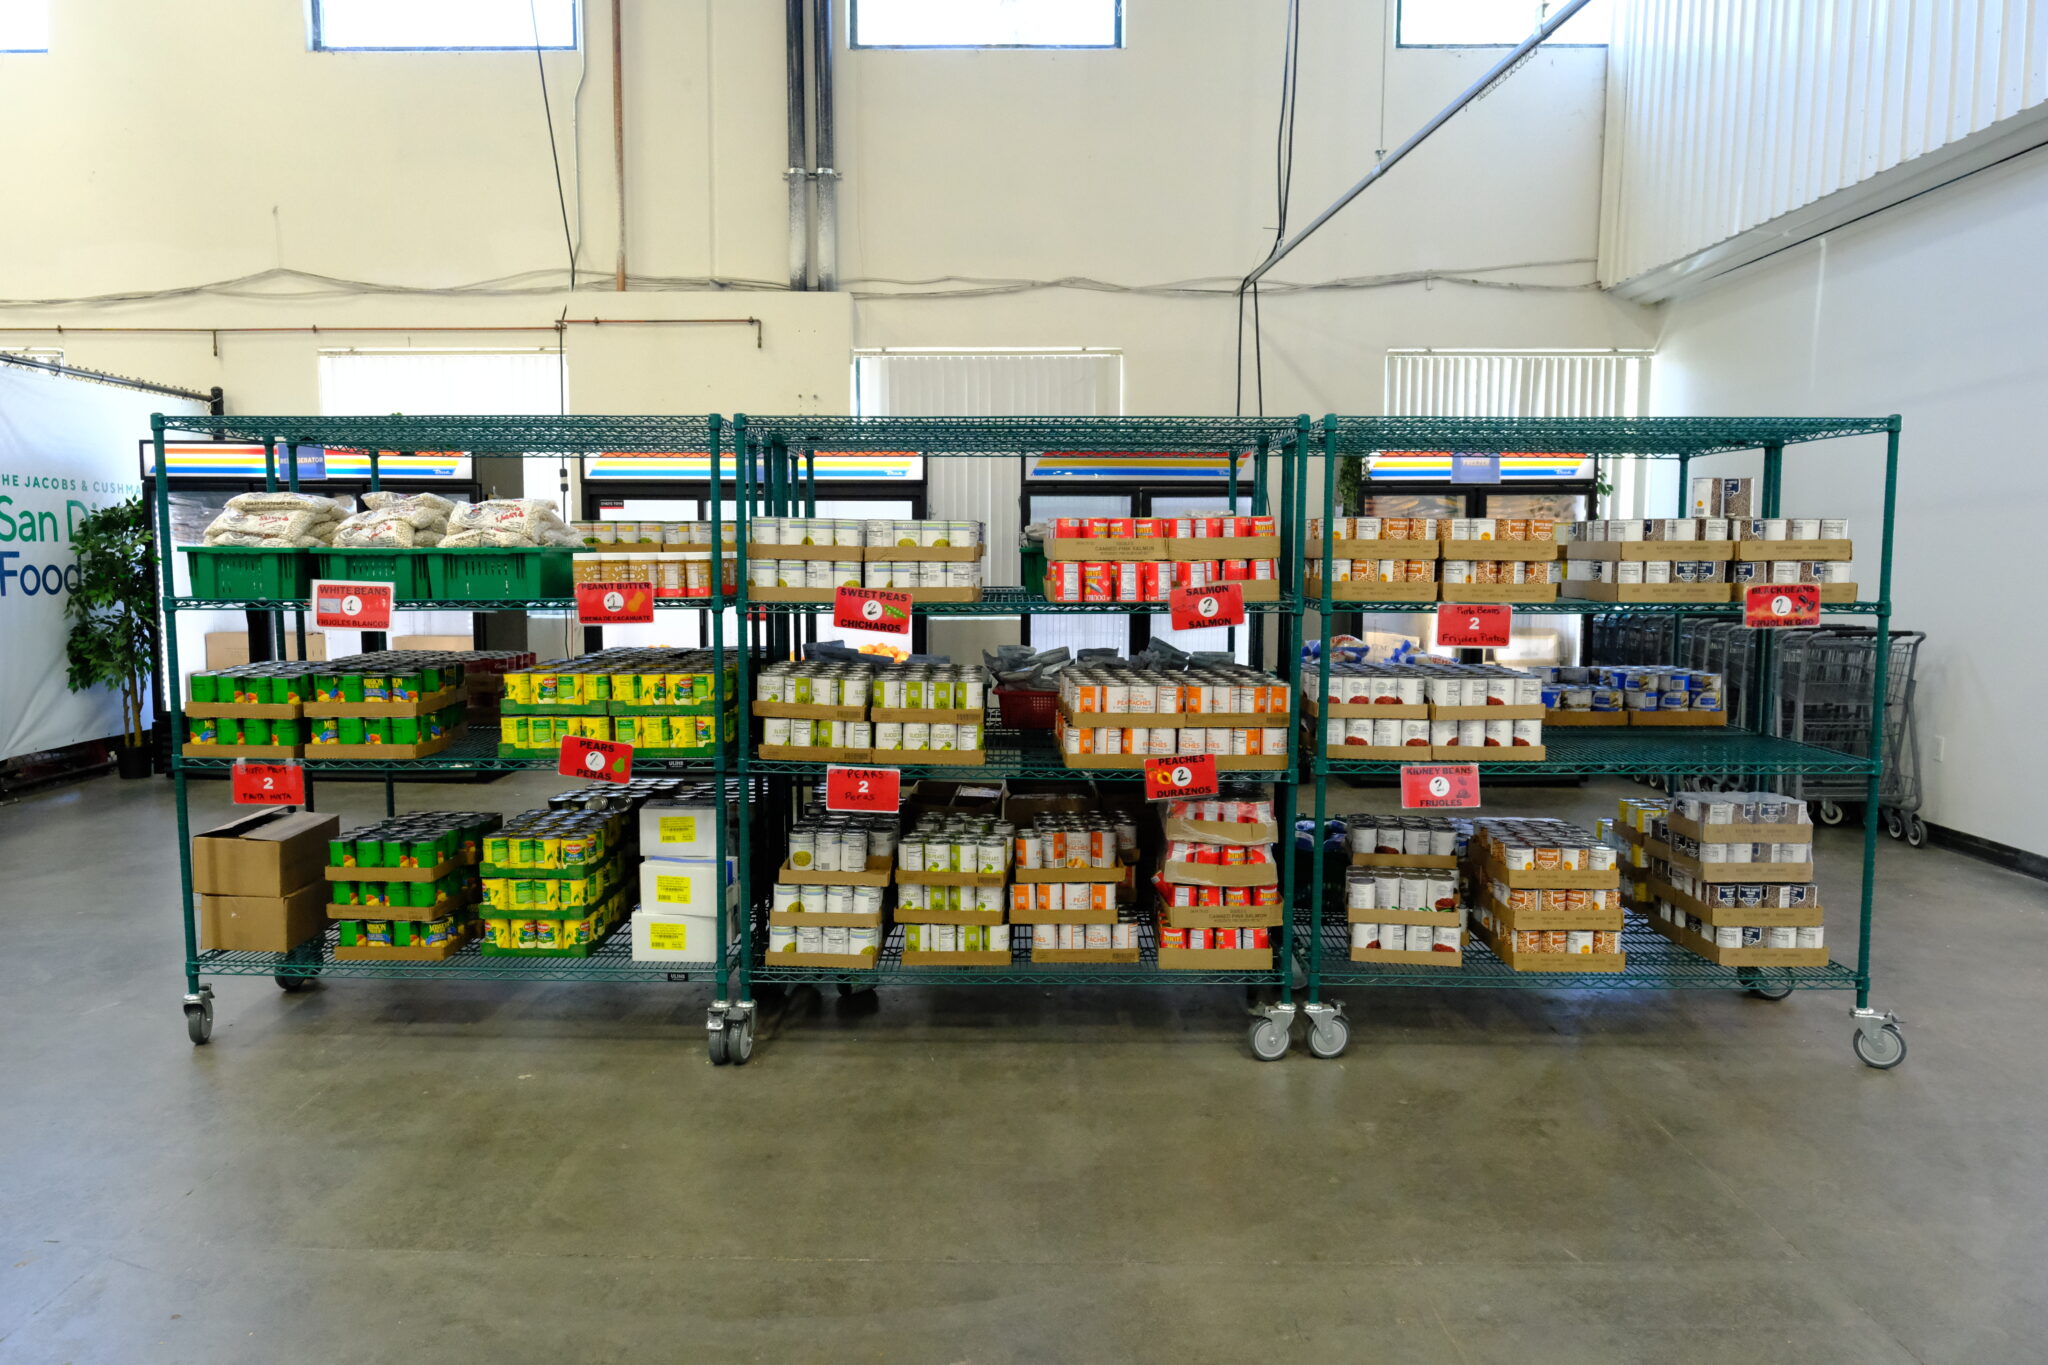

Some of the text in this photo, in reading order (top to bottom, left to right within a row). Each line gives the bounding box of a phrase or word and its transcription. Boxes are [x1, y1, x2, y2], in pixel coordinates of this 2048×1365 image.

[24, 476, 76, 491] JACOBS
[81, 481, 88, 492] &
[0, 495, 58, 543] San
[0, 549, 82, 597] Food
[320, 586, 388, 596] WHITE BEANS
[841, 588, 908, 602] SWEET PEAS
[1186, 585, 1229, 596] SALMON
[1751, 585, 1815, 594] BLACK BEANS
[346, 599, 355, 611] 1
[607, 594, 621, 609] 1
[1203, 598, 1213, 614] 2
[1775, 598, 1786, 614] 2
[1477, 606, 1500, 615] Beans
[352, 619, 389, 627] BLANCOS
[841, 619, 901, 632] CHICHAROS
[1188, 618, 1232, 629] SALMON
[1468, 616, 1480, 630] 2
[1751, 619, 1780, 627] FRIJOL
[579, 740, 615, 753] PEARS
[1158, 754, 1205, 766] PEACHES
[576, 768, 612, 781] PERAS
[847, 769, 884, 779] PEARS
[1177, 769, 1188, 781] 2
[1406, 766, 1473, 775] KIDNEY BEANS
[263, 776, 274, 790] 2
[858, 780, 869, 793] 2
[844, 791, 876, 801] Peras
[1156, 786, 1212, 798] DURAZNOS
